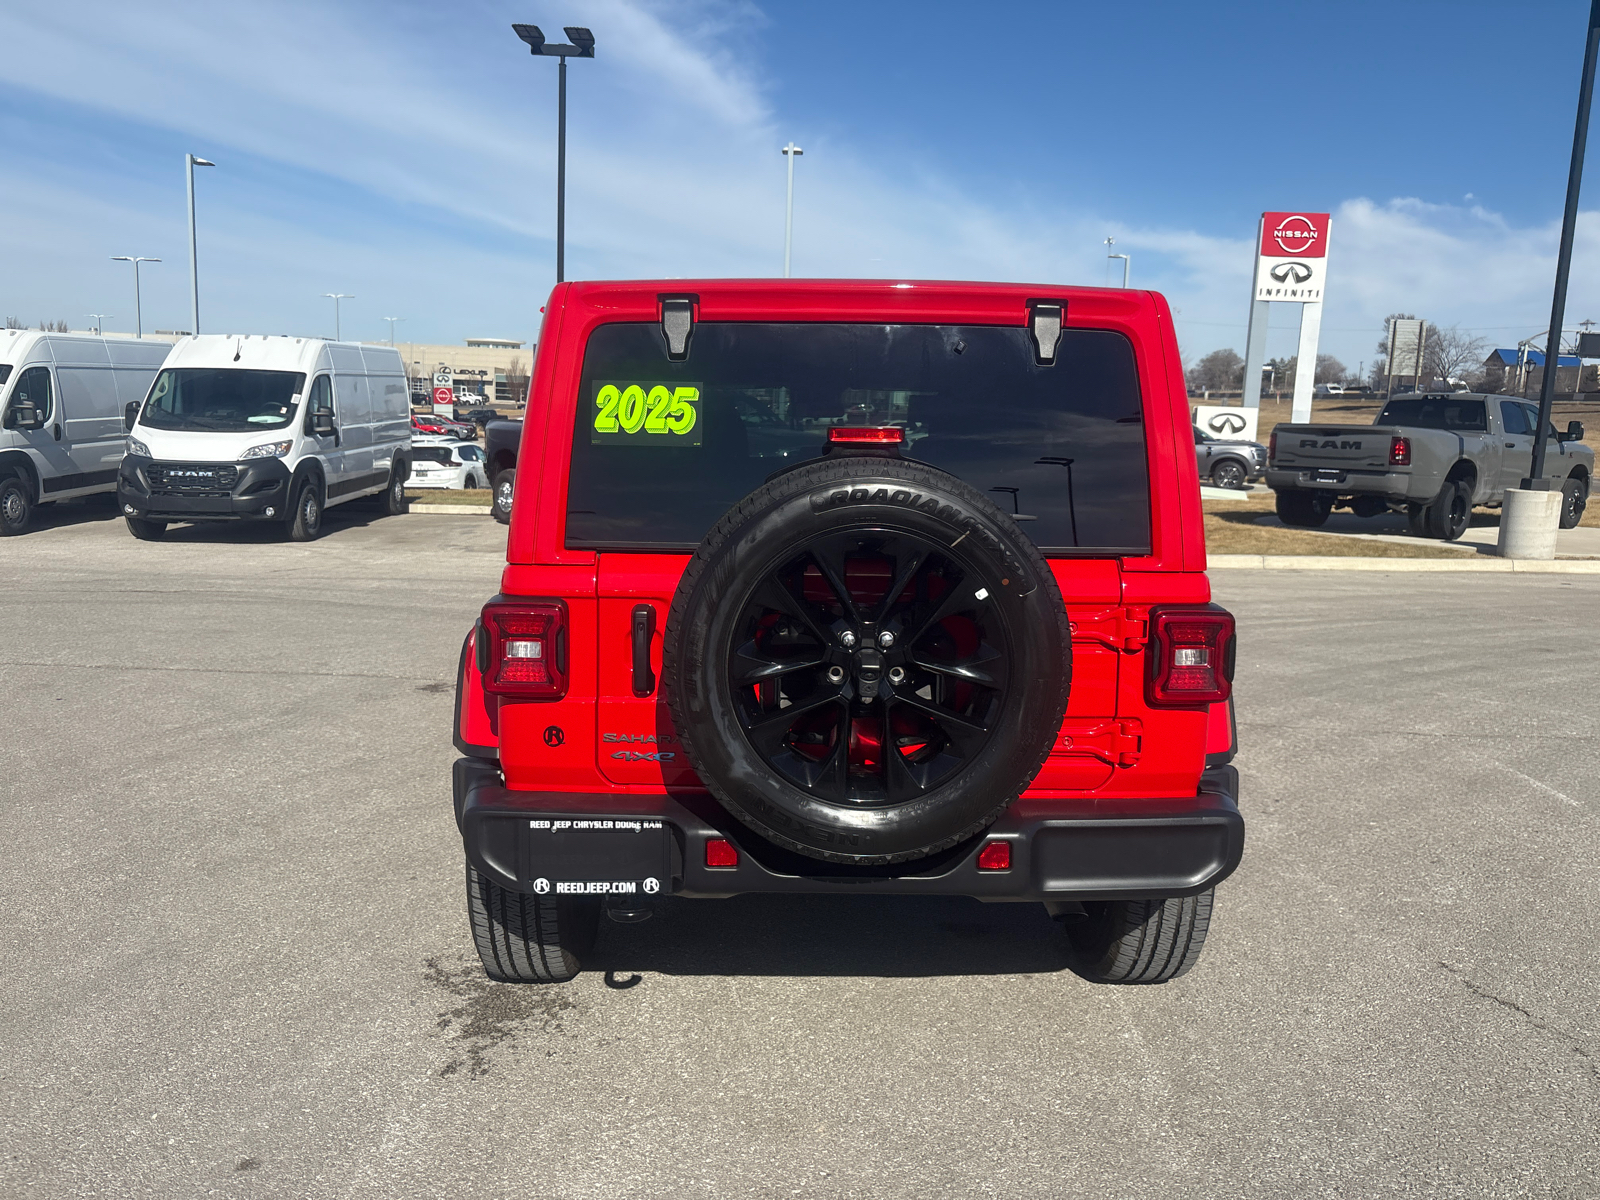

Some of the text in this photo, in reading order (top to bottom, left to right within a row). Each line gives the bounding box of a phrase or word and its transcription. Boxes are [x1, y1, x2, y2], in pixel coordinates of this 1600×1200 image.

[1273, 230, 1318, 238] NISSAN
[1259, 288, 1320, 298] INFINITI
[594, 384, 700, 435] 2025
[1299, 439, 1362, 450] RAM
[829, 488, 962, 526] ROADIAN
[529, 820, 663, 829] REED JEEP CHRYSLER DODGE RAM
[556, 882, 636, 894] REEDJEEP.COM
